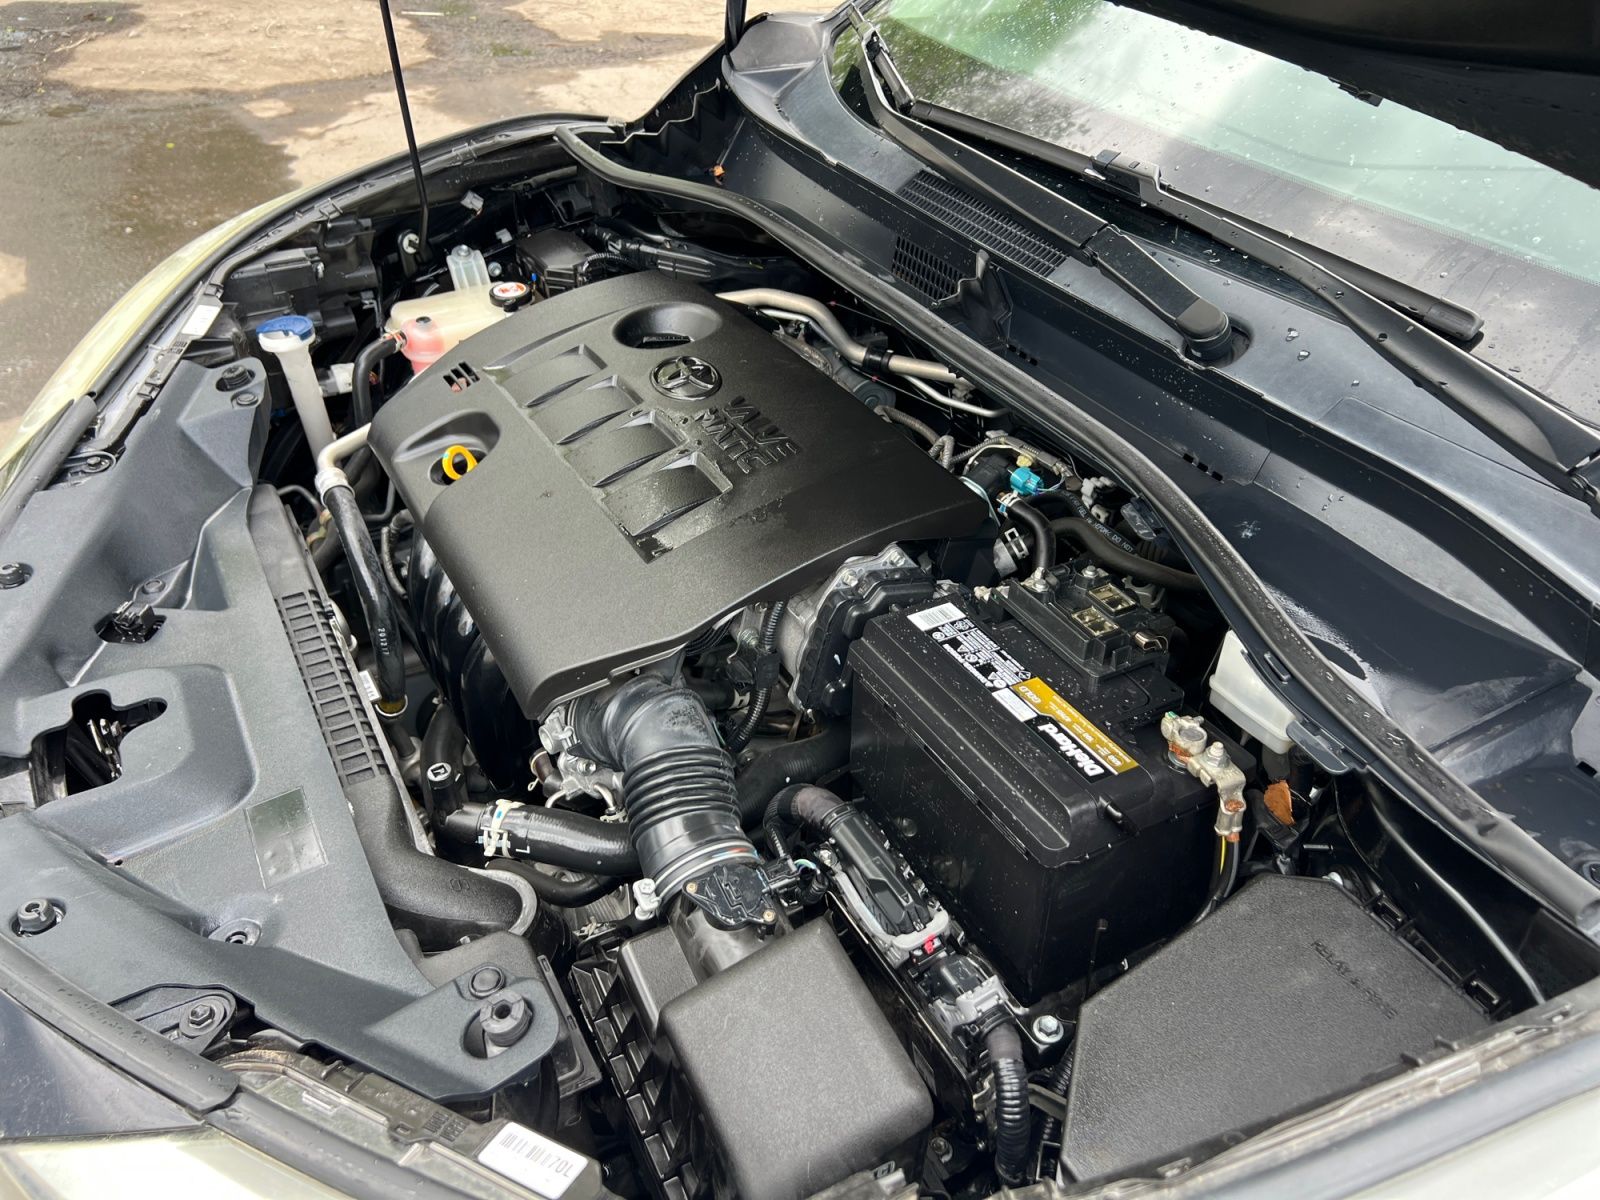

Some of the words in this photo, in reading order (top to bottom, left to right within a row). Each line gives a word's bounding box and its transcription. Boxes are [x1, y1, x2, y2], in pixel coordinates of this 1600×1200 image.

[722, 395, 798, 462] VALVE
[1018, 685, 1041, 704] GOLD
[1037, 723, 1105, 777] DieHard
